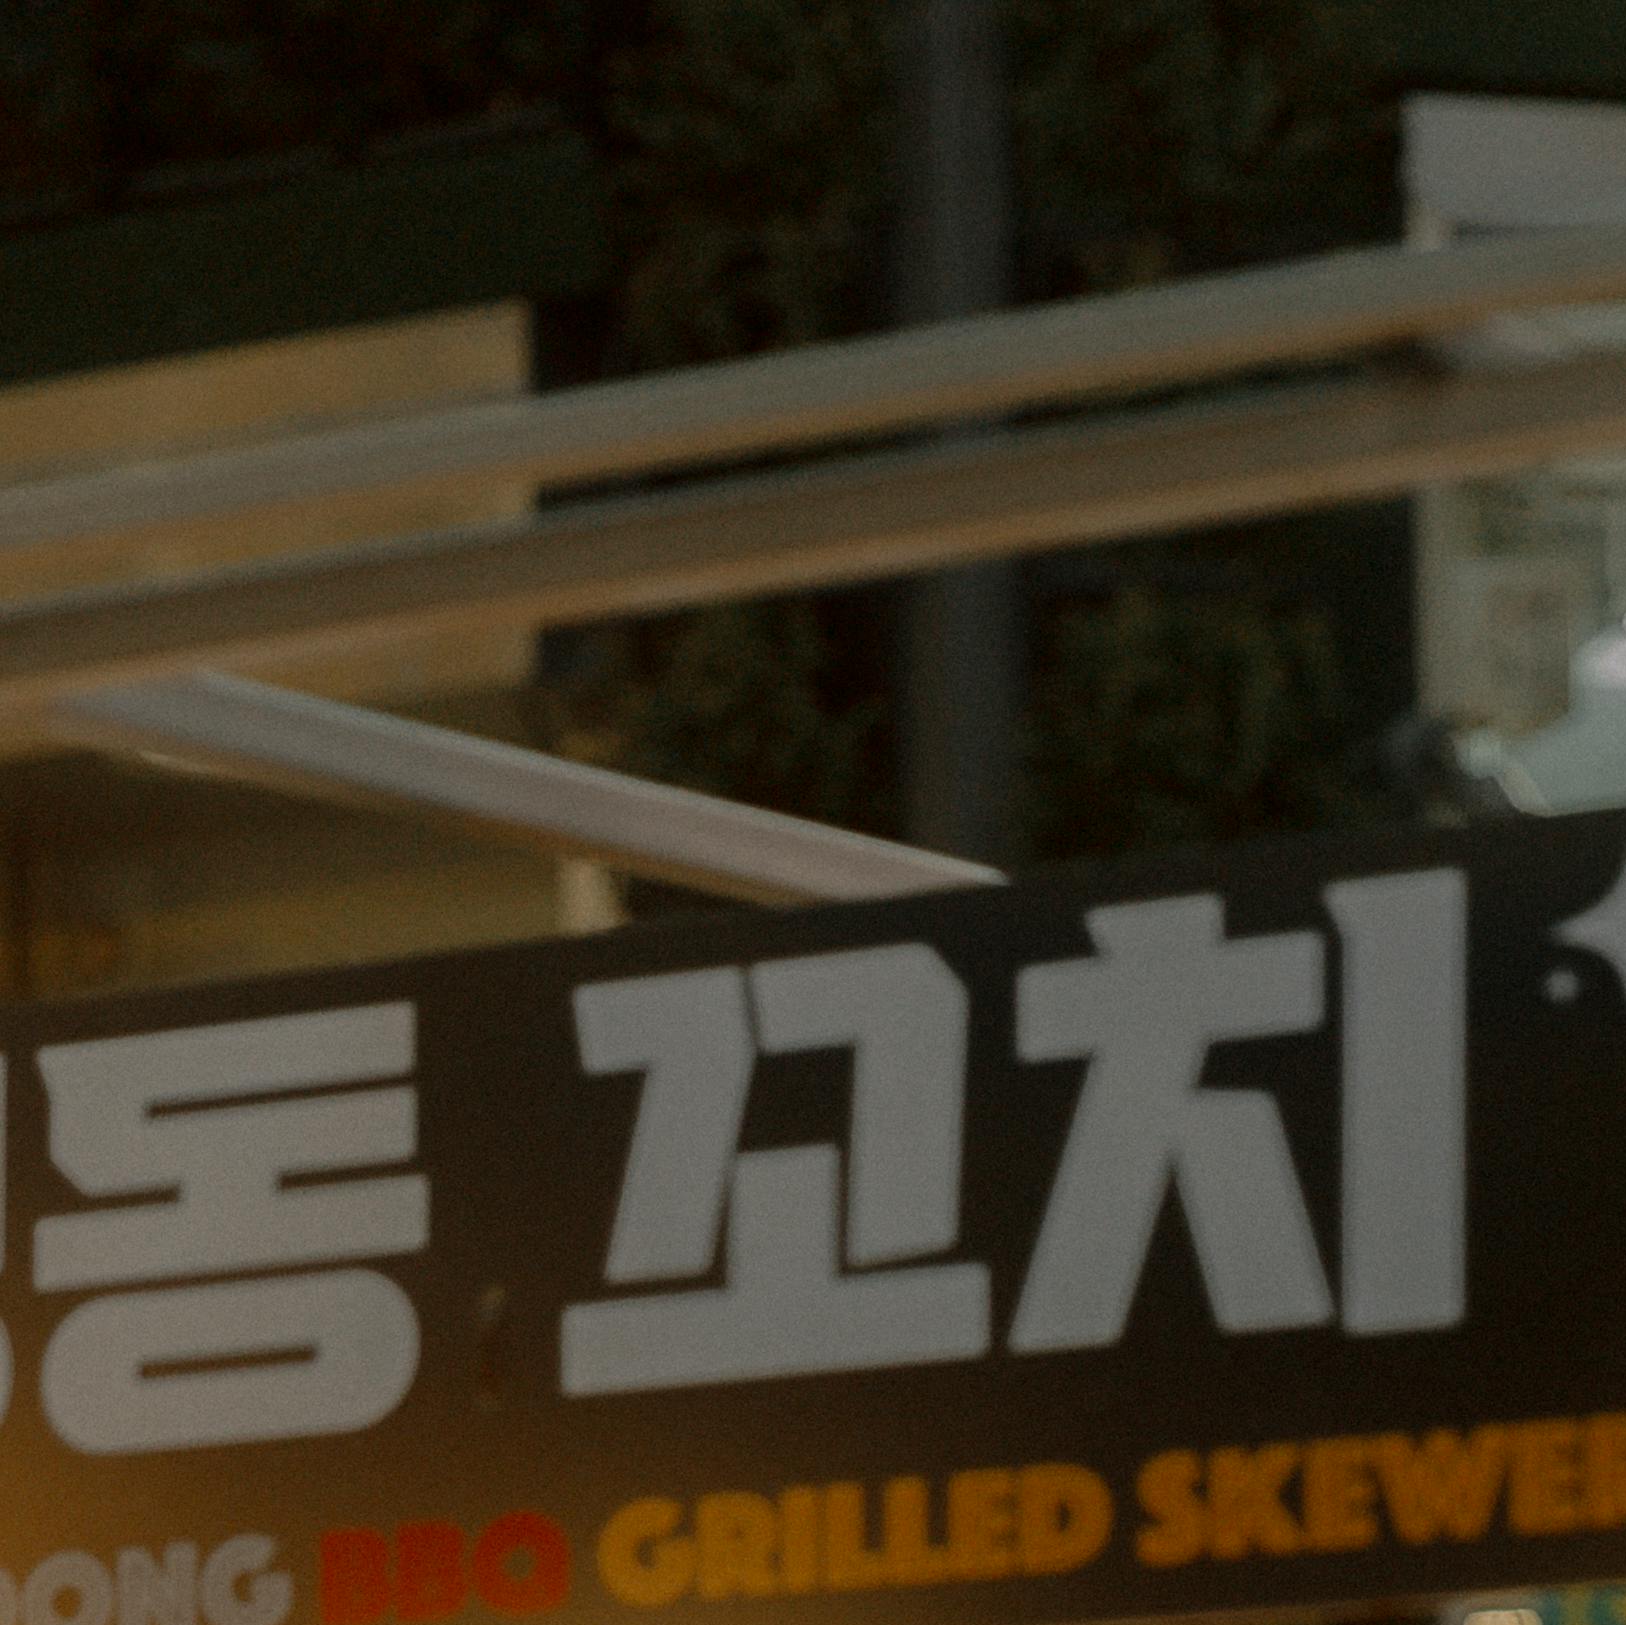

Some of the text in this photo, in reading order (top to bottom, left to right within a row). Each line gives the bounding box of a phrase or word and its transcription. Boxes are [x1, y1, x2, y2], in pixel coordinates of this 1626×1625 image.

[0, 866, 1469, 1458] 동 꼬치
[598, 1458, 1114, 1609] GRILLED
